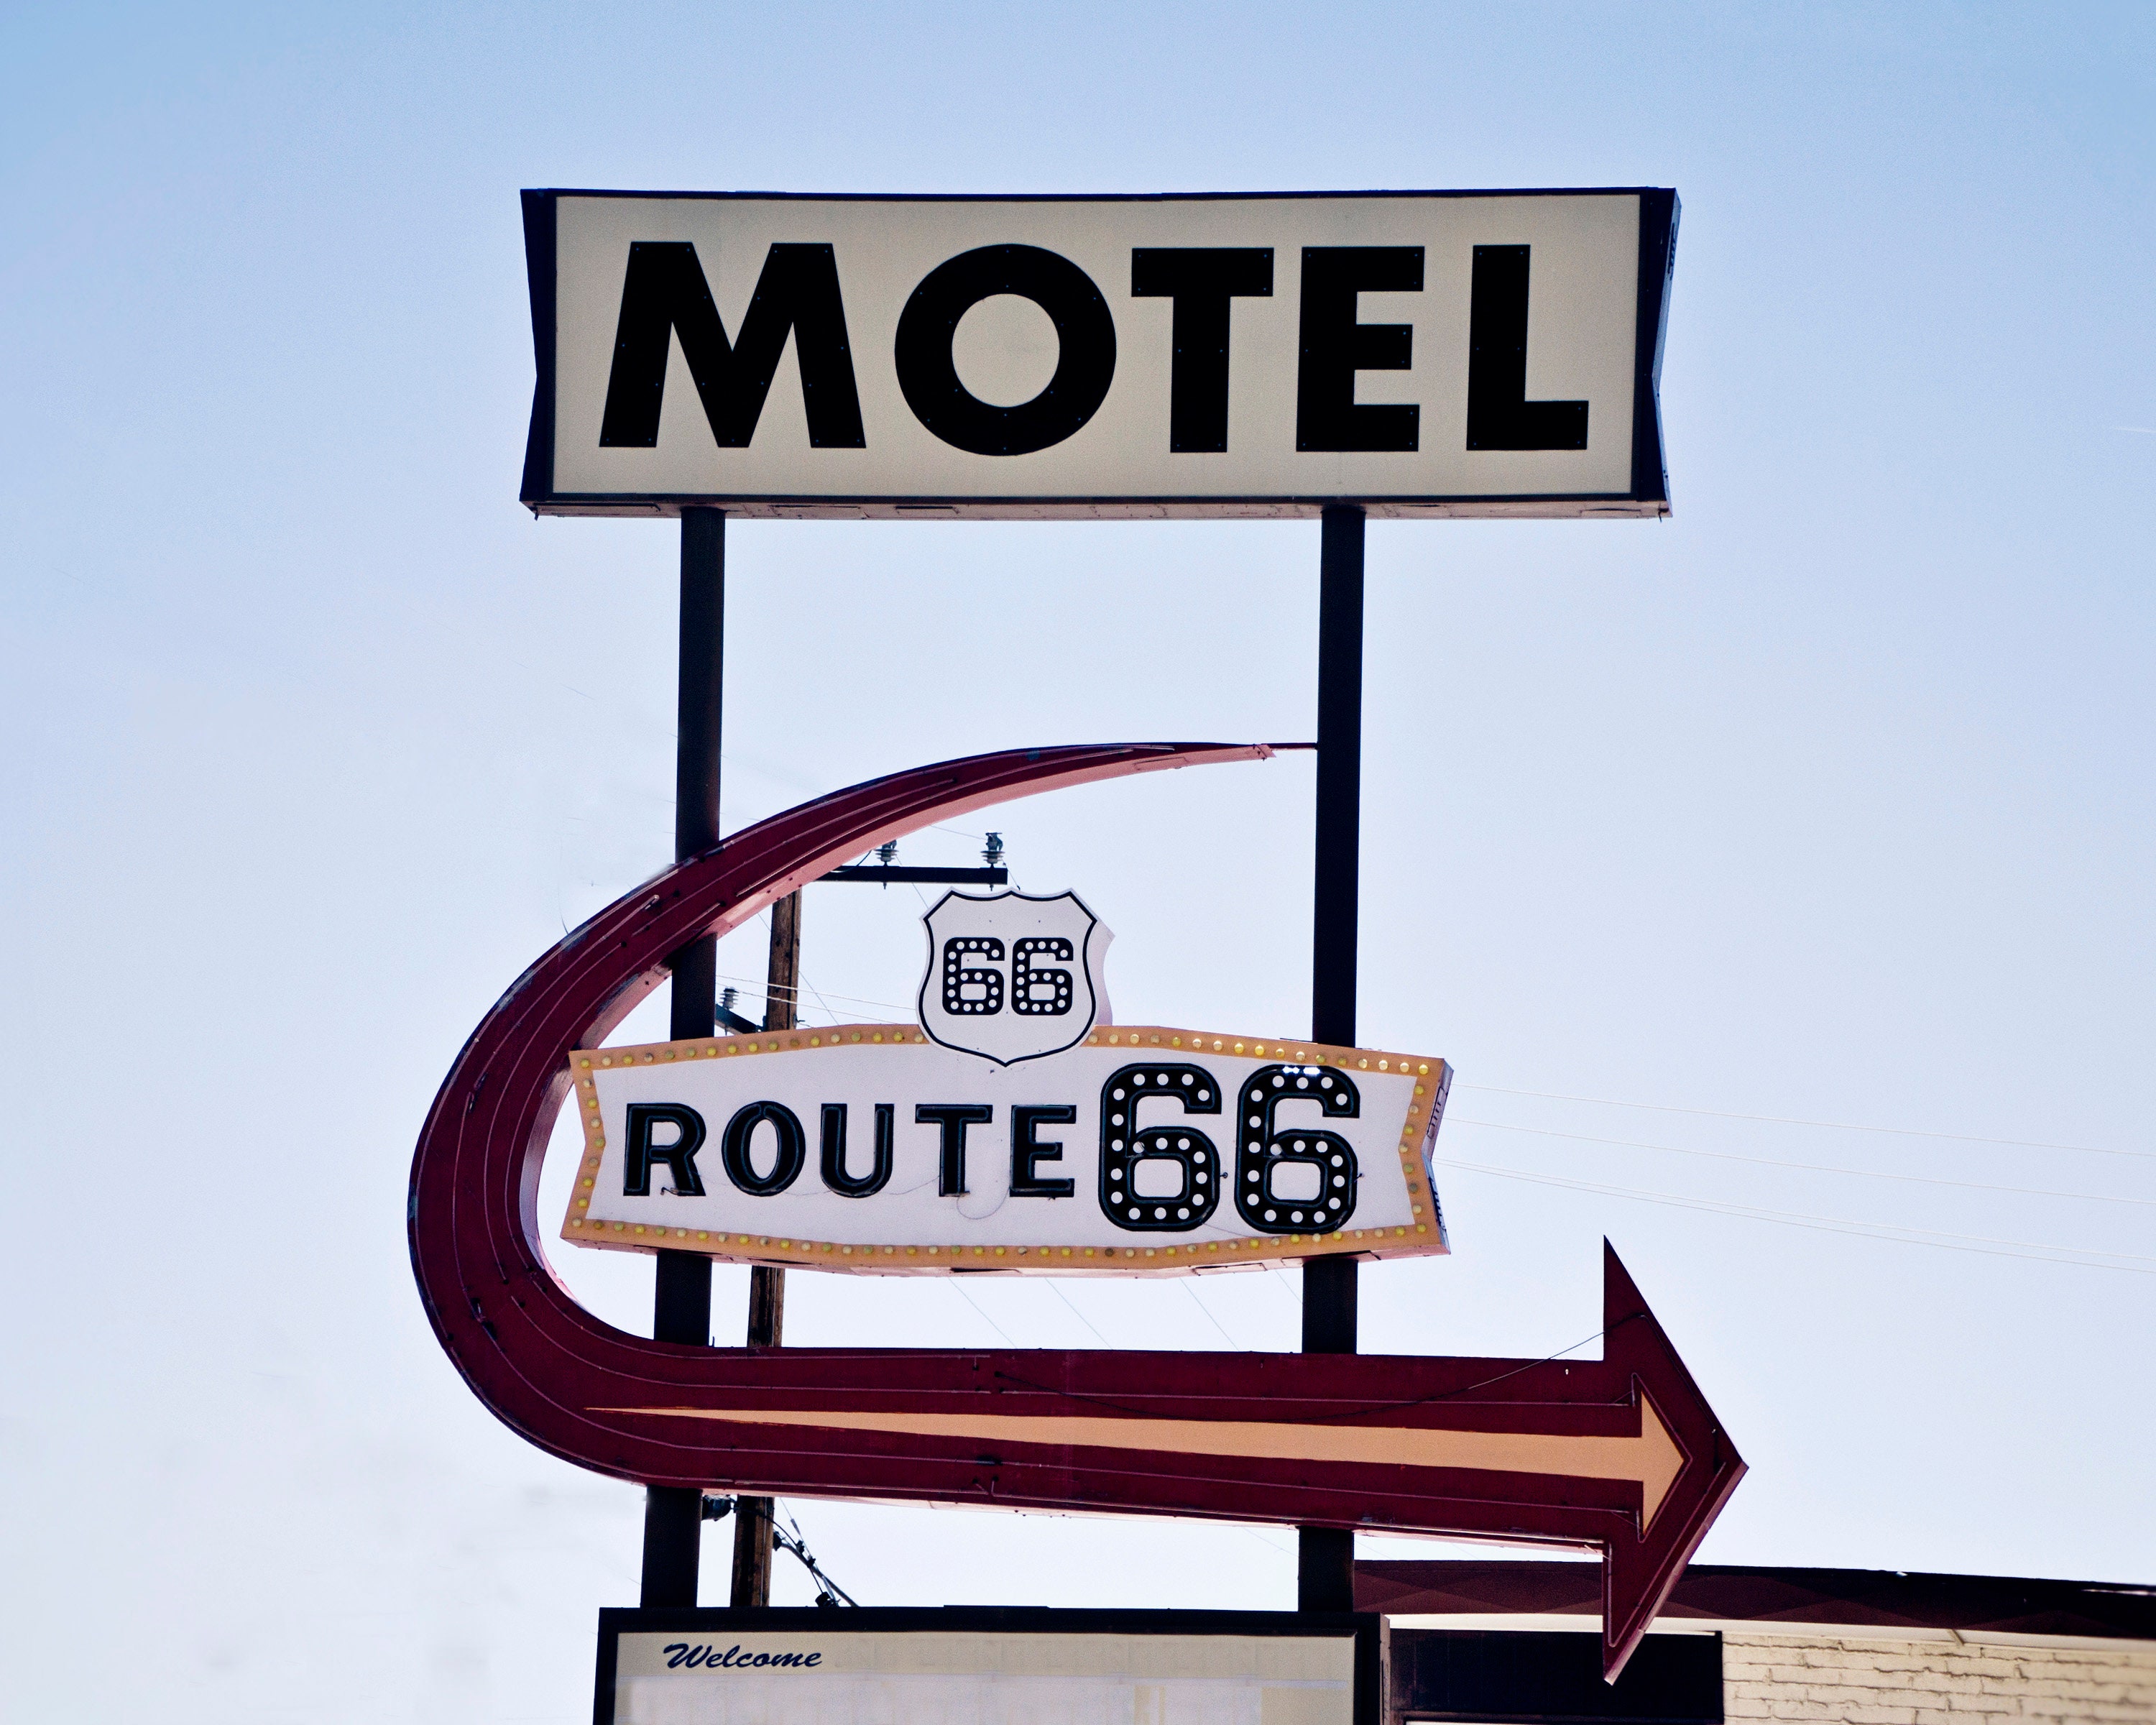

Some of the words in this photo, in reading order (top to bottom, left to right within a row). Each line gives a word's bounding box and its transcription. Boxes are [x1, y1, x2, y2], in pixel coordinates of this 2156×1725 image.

[599, 240, 1590, 456] MOTEL
[941, 937, 1074, 1016] 66
[622, 1100, 1078, 1200] ROUTE
[1097, 1062, 1363, 1237] 66
[663, 1642, 823, 1670] Welcome
